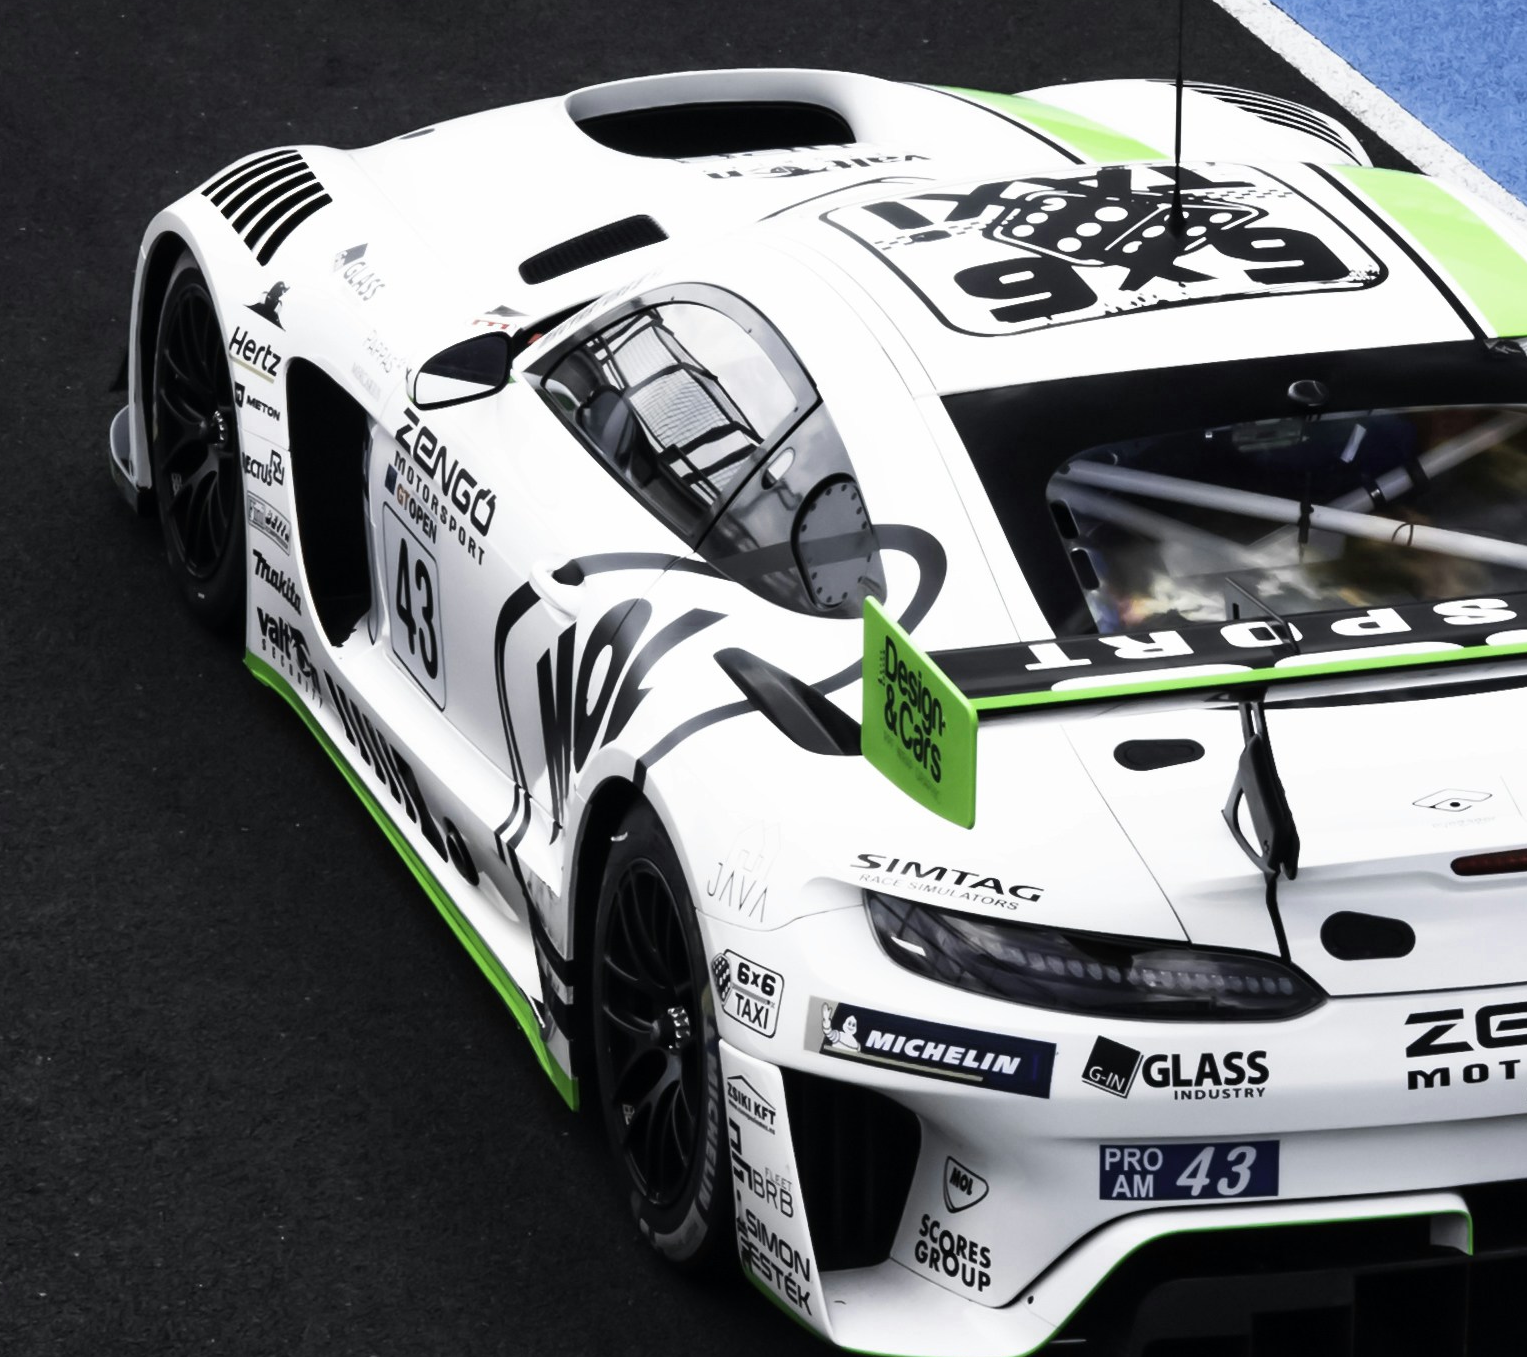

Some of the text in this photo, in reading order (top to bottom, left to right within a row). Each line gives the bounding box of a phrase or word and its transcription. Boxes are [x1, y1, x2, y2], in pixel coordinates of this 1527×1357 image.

[229, 326, 281, 377] Hertz
[246, 395, 280, 421] METON
[394, 450, 485, 565] MOTORSPORT
[252, 548, 302, 616] makita
[396, 538, 438, 680] 43
[706, 861, 768, 923] JAVA
[849, 853, 1044, 903] SIMTAG
[858, 873, 1020, 911] RACE SIMULATORS
[737, 961, 776, 997] 6x6
[735, 992, 770, 1030] TAXI
[864, 1029, 1022, 1075] MICHELIN
[1141, 1050, 1270, 1088] GLASS
[1088, 1065, 1126, 1092] G-IN
[1173, 1087, 1266, 1101] INDUSTRY
[726, 1081, 752, 1112] ZSIKI
[753, 1101, 776, 1126] KFT
[698, 1050, 719, 1212] MICHELIN
[949, 1167, 973, 1196] MOL
[1104, 1147, 1164, 1172] PRO
[1175, 1145, 1258, 1197] 43
[752, 1168, 794, 1219] BRB
[1111, 1173, 1155, 1198] AM
[745, 1208, 811, 1283] SIMON
[918, 1213, 992, 1269] SCORES
[914, 1239, 992, 1293] GROUP
